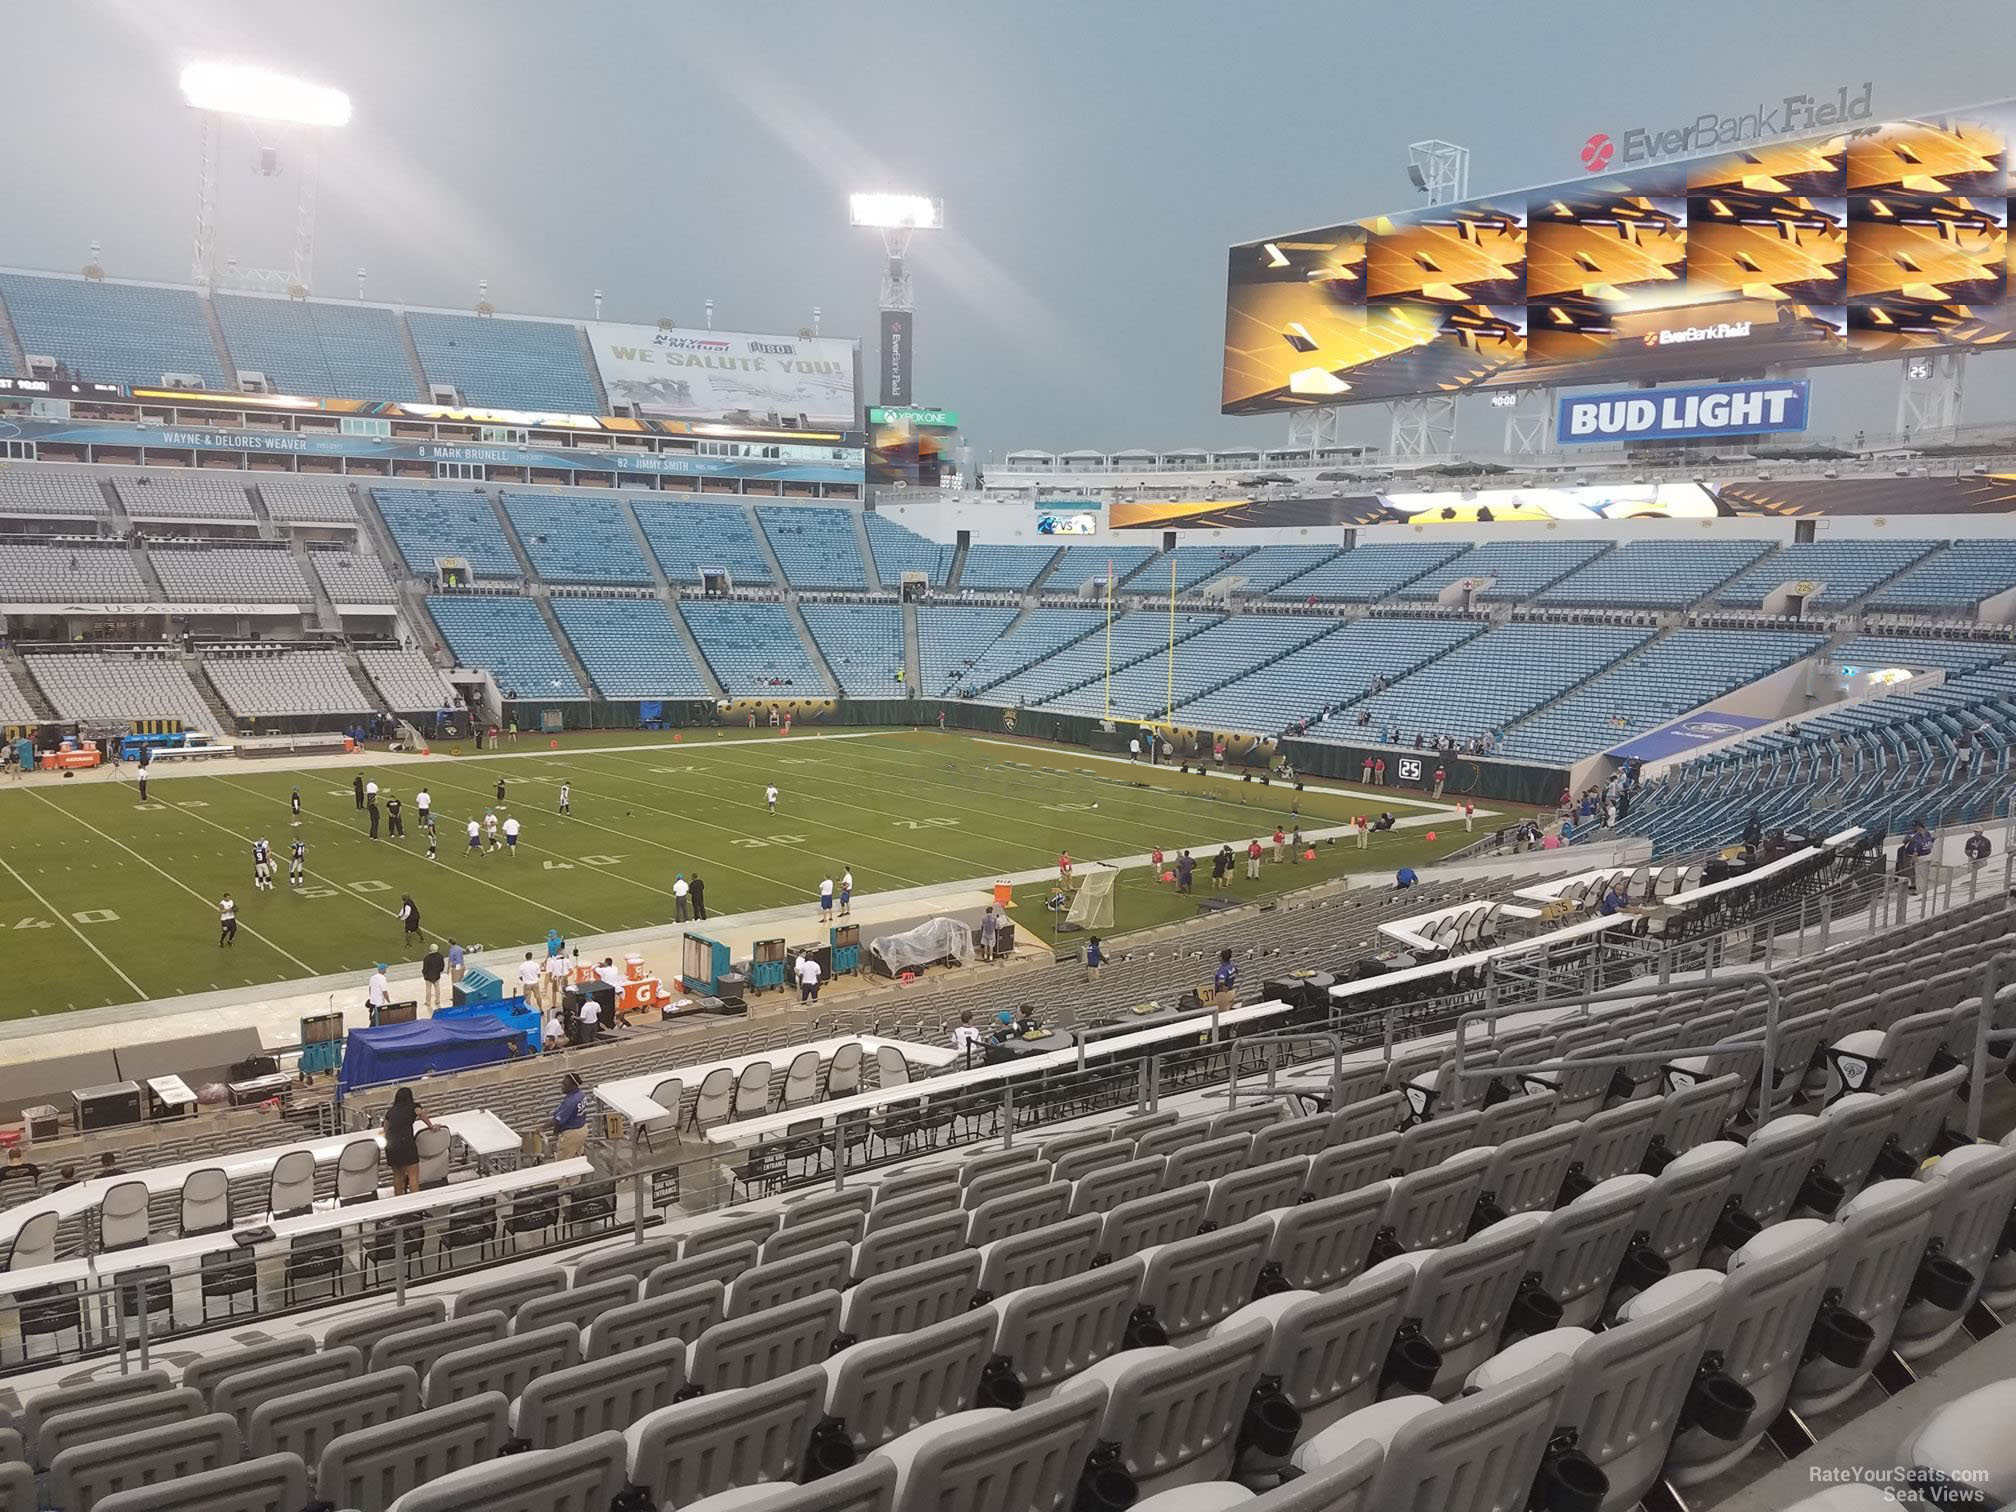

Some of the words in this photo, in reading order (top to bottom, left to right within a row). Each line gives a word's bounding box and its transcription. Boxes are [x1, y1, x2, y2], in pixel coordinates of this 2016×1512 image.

[655, 335, 697, 344] Navy
[669, 342, 729, 352] Mutual
[611, 345, 655, 363] WE
[666, 352, 768, 372] SALUTE
[777, 360, 841, 375] YOU!
[1911, 366, 1926, 378] 25
[1492, 395, 1516, 406] 90:00
[1571, 399, 1656, 435] BUD
[1661, 389, 1793, 430] LIGHT
[163, 432, 200, 444] WAYNE
[204, 434, 211, 444] &
[215, 436, 262, 448] DELORES
[265, 438, 306, 450] WEAVER
[419, 446, 425, 457] 8
[434, 447, 461, 458] MARK
[464, 450, 508, 461] BRUNELL
[617, 458, 628, 468] 82
[635, 460, 661, 470] JIMMY
[663, 461, 689, 471] SMITH
[1060, 521, 1073, 531] VS
[1797, 584, 1811, 592] 225
[104, 605, 136, 613] US
[143, 605, 214, 613] Assure
[219, 605, 266, 613] Club
[1402, 761, 1419, 777] 25
[256, 852, 263, 861] 9
[543, 854, 622, 870] 40
[294, 879, 393, 899] 50
[12, 908, 121, 931] 40
[636, 985, 651, 1002] G
[1203, 989, 1214, 1002] 37
[653, 1186, 677, 1199] ENTRANCE
